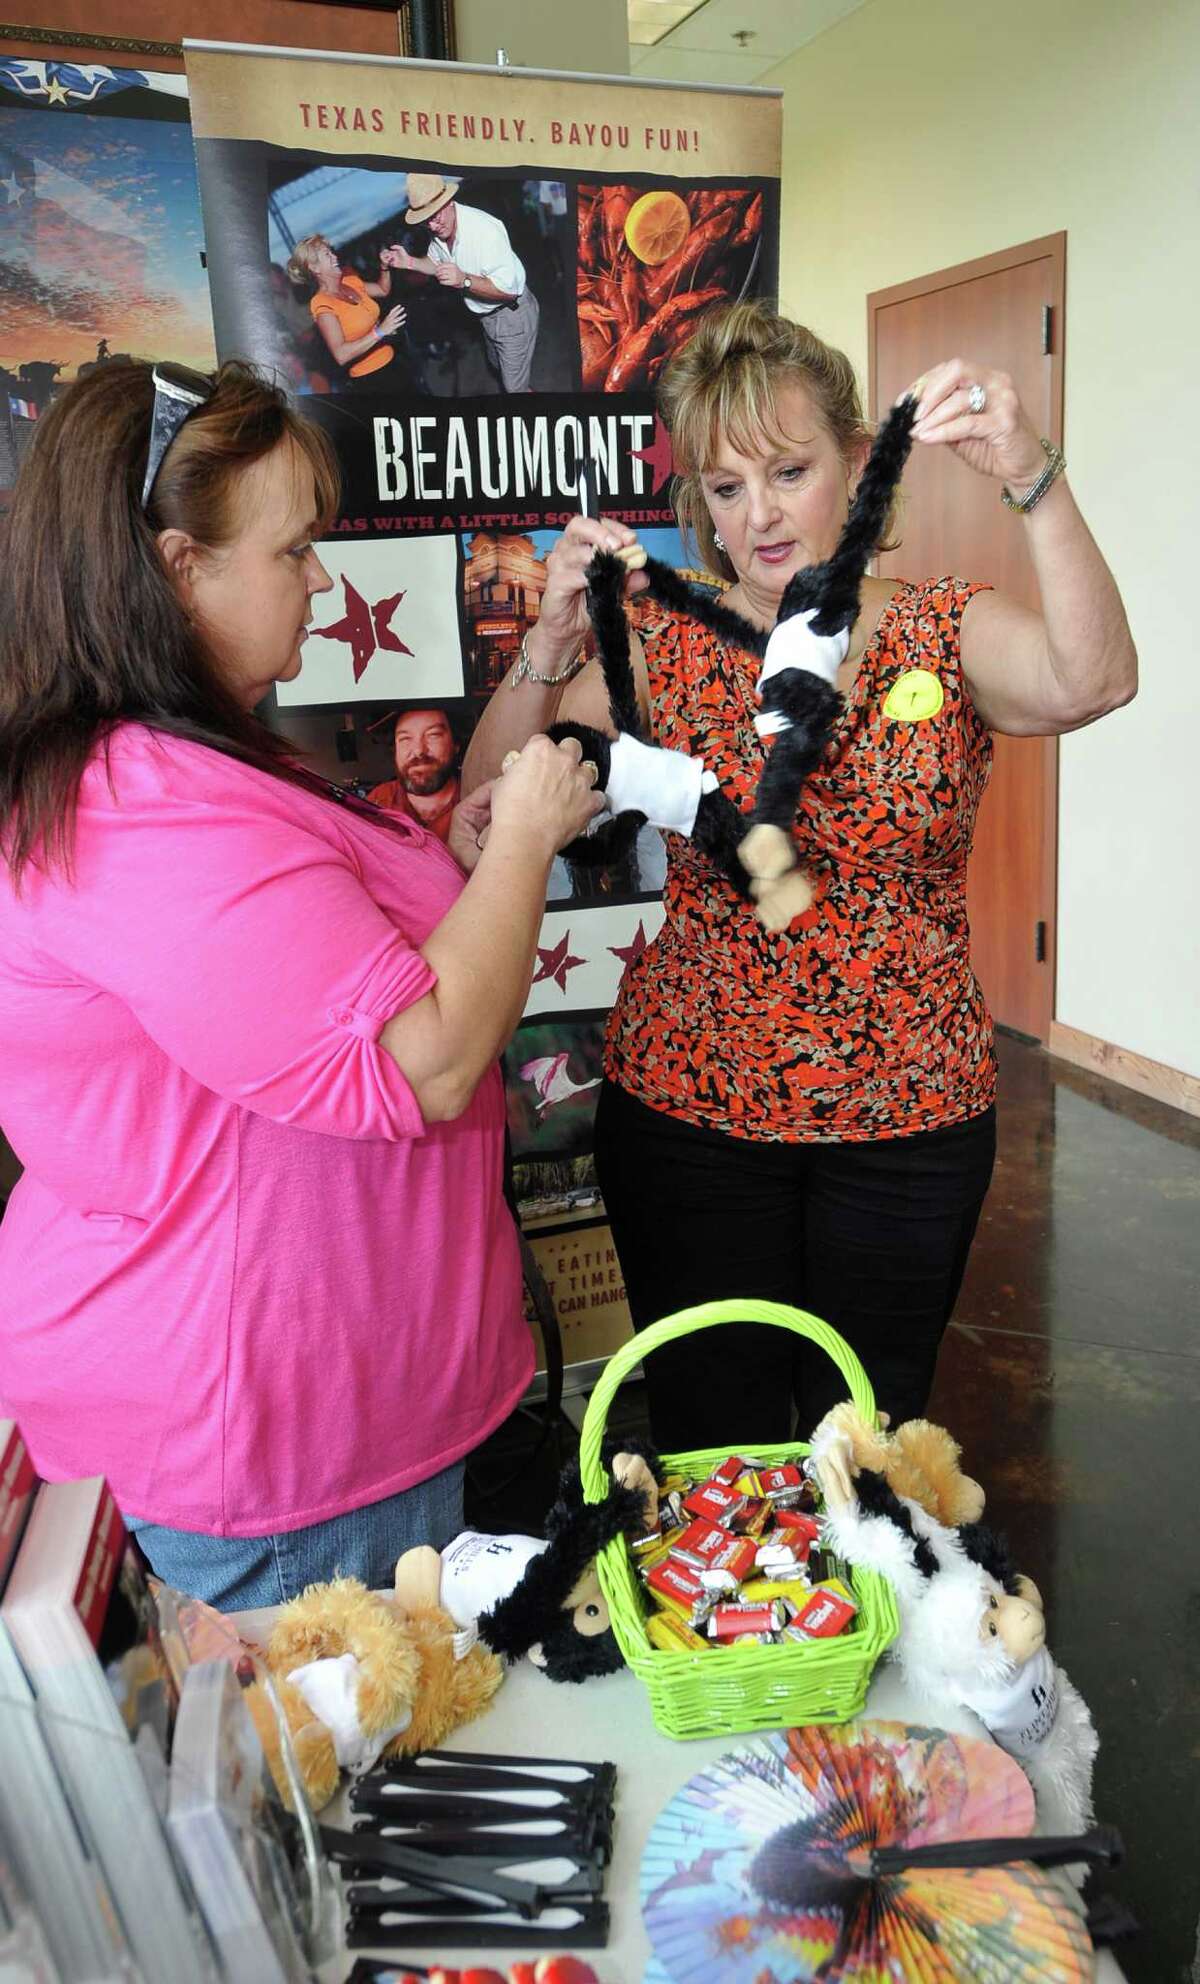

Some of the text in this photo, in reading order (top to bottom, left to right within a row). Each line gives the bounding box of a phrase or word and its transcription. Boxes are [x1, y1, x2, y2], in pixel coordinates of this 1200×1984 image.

[299, 103, 699, 152] TEXAS FRIENDLY. BAYOU FUN!
[372, 415, 653, 501] BEAUMONT
[372, 515, 435, 531] WITH
[440, 514, 455, 529] A
[459, 511, 540, 528] LITTLE
[544, 508, 676, 526] SOTHING
[569, 1268, 617, 1292] TIME
[558, 1295, 586, 1314] CAN
